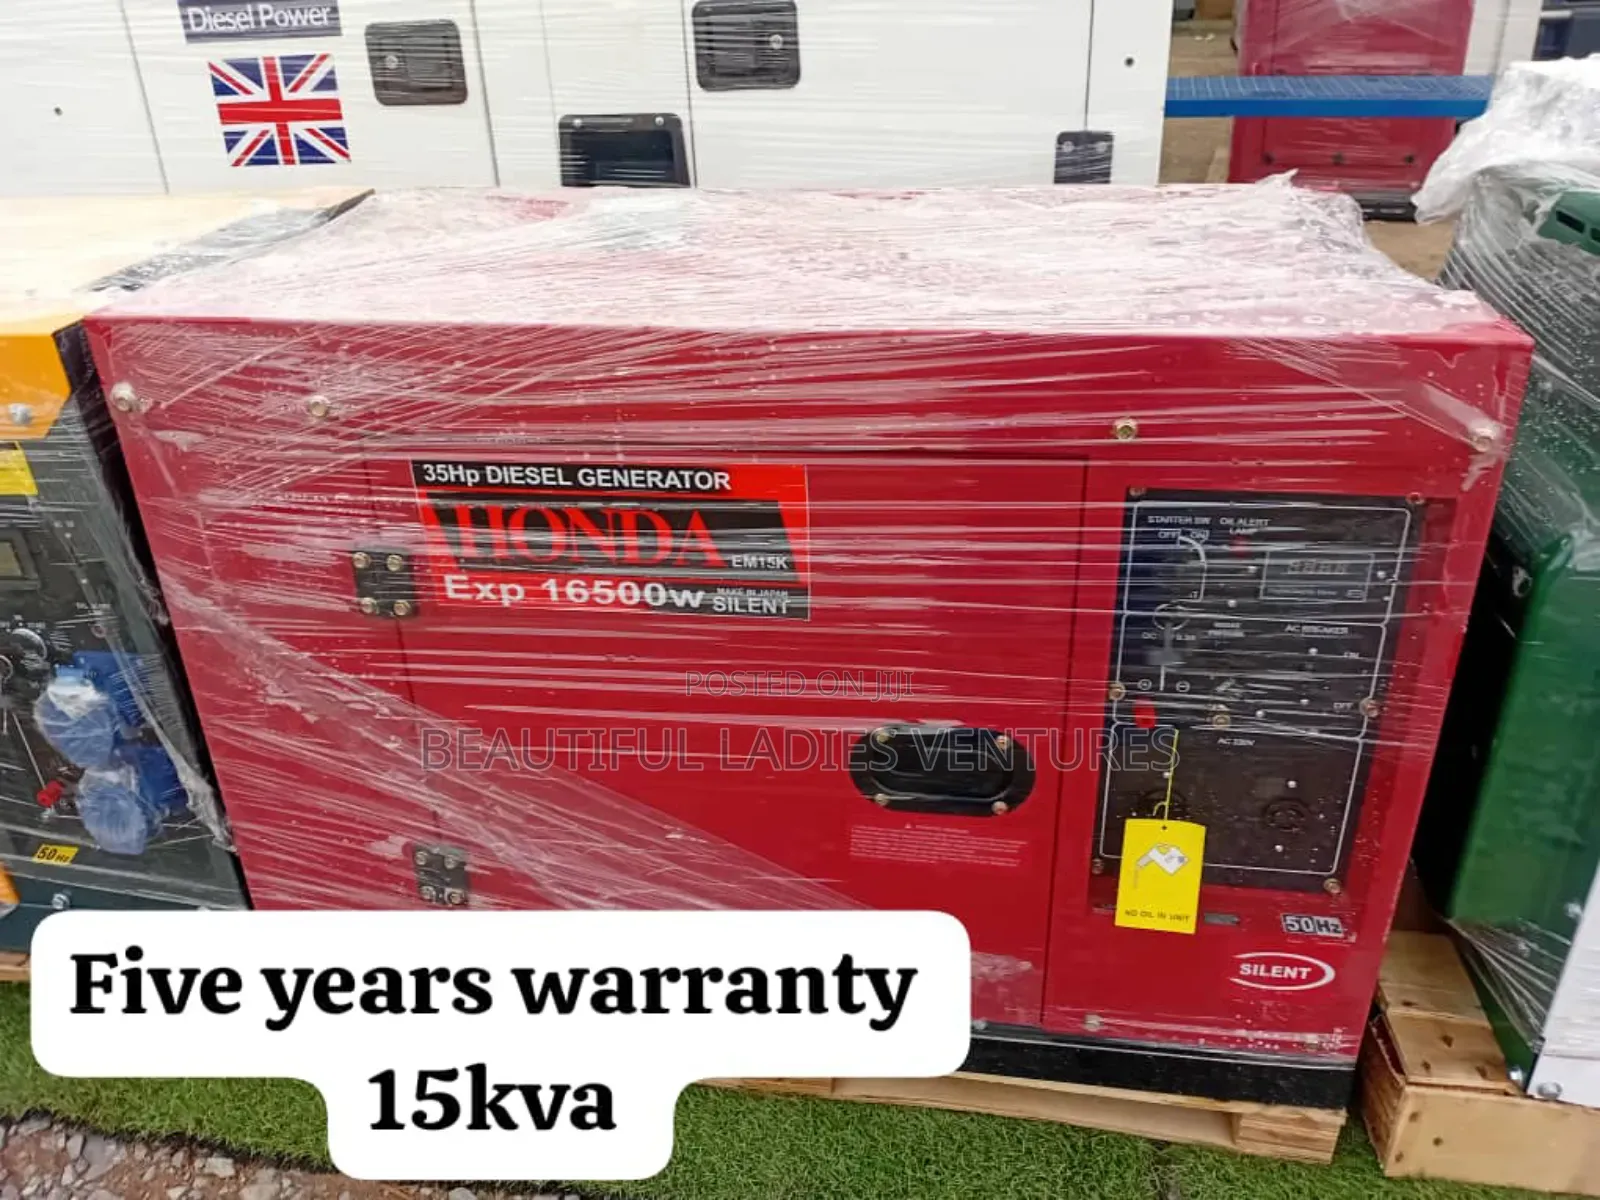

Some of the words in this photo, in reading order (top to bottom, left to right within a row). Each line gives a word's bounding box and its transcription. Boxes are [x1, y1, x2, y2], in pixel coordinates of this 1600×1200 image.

[186, 5, 256, 32] Diesel
[257, 4, 332, 29] Power
[423, 464, 479, 486] 35Hp
[486, 467, 573, 486] DIESEL
[577, 468, 732, 490] GENERATOR
[451, 505, 726, 567] HONDA
[731, 553, 790, 570] EM15K
[443, 574, 525, 606] Exp
[541, 579, 706, 609] 16500w
[713, 596, 791, 614] SILENT
[1286, 917, 1343, 935] 50Hz
[1239, 964, 1312, 980] SILENT
